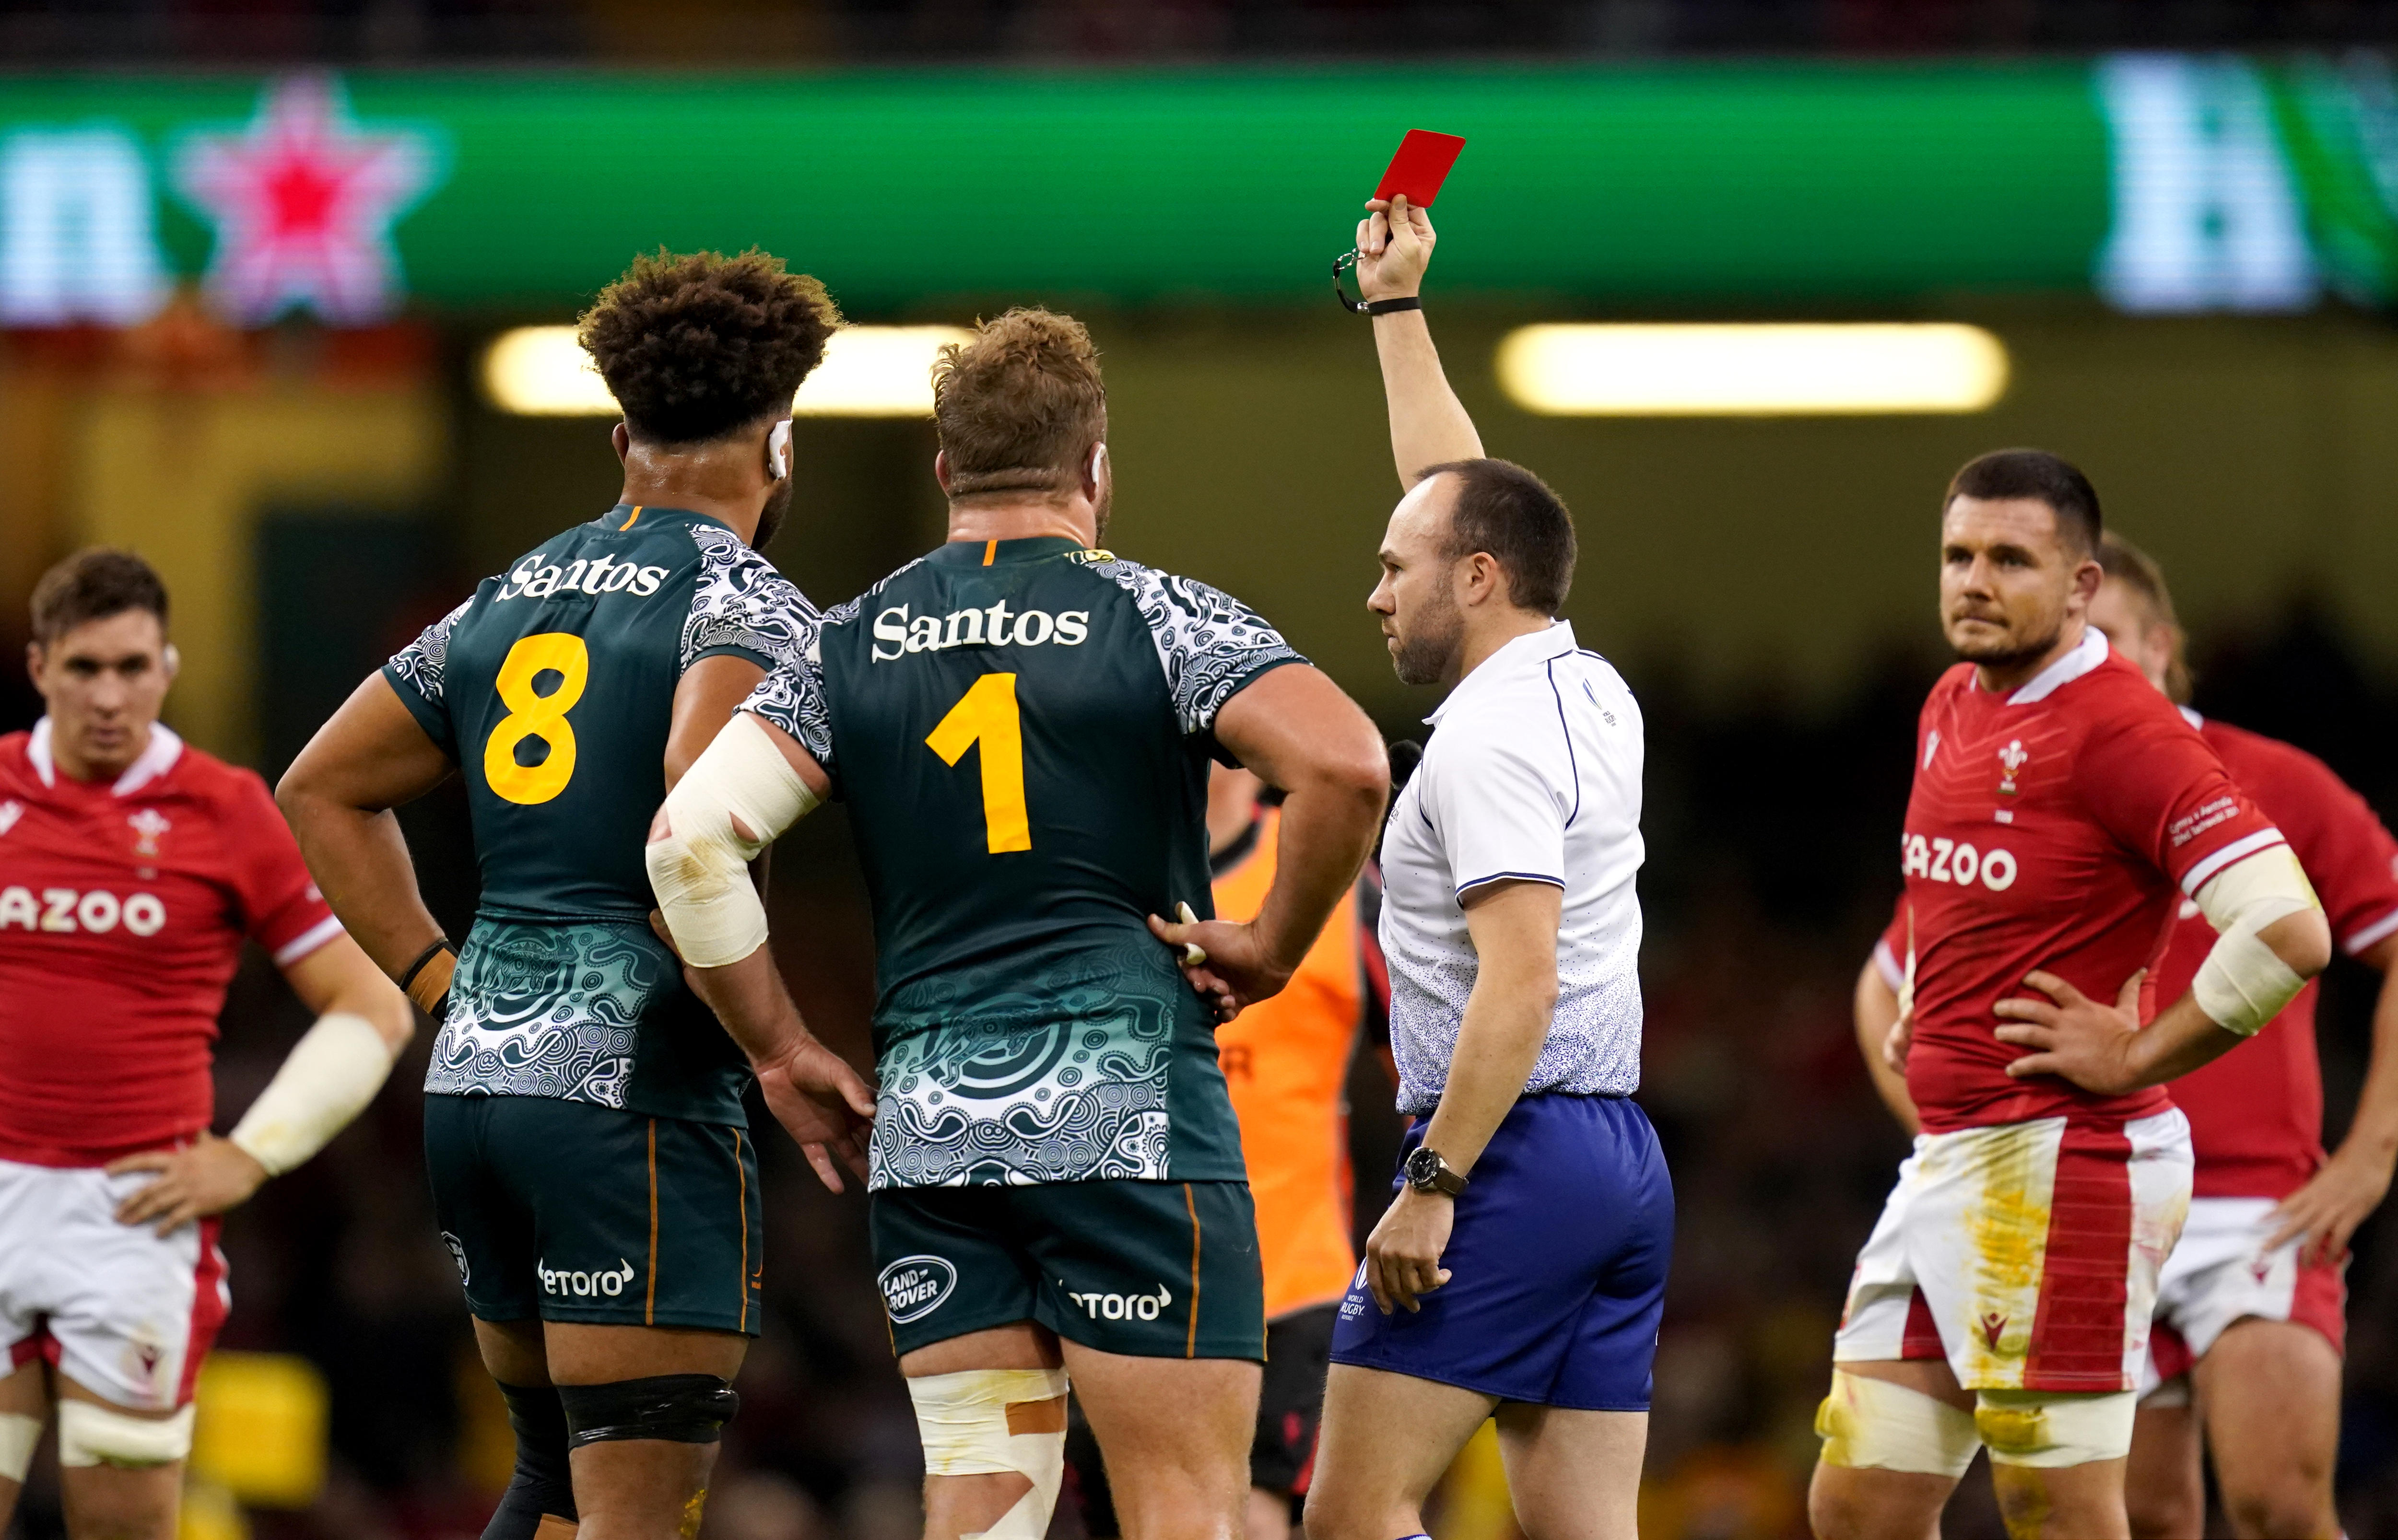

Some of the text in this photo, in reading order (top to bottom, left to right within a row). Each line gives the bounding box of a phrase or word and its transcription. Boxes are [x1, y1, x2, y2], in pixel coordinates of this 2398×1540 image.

[495, 553, 670, 602] Santos
[871, 599, 1089, 663] Santos
[484, 632, 588, 805] 8
[925, 672, 1032, 854] 1
[1340, 1302, 1365, 1316] RUGBY
[1348, 1294, 1364, 1303] WORLD
